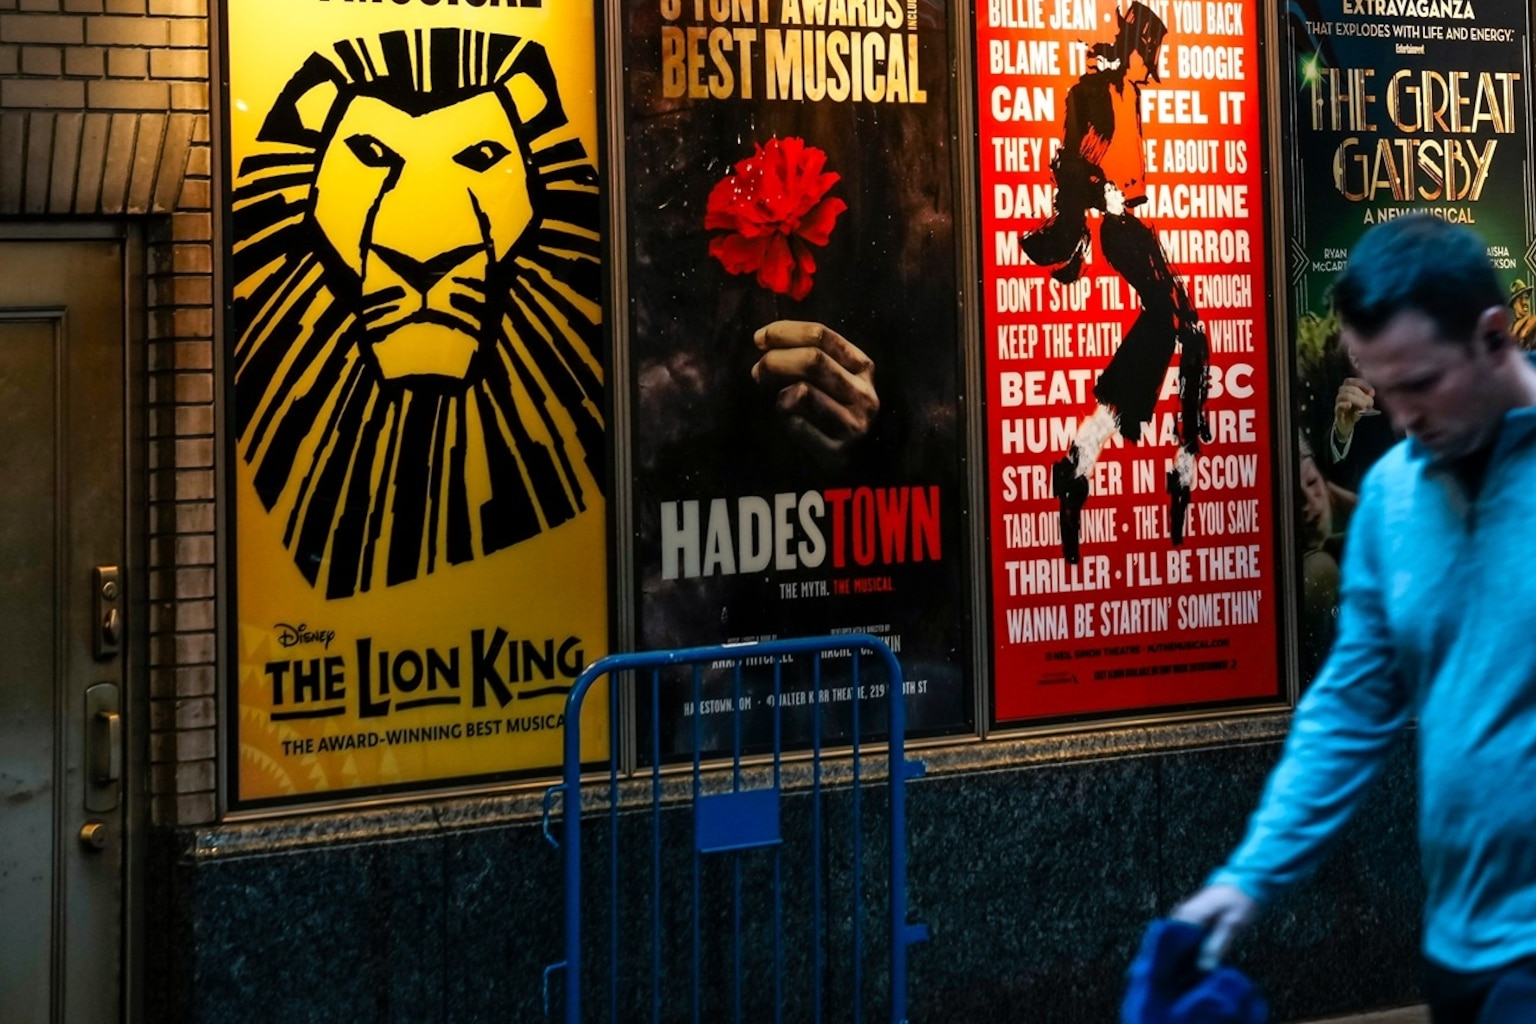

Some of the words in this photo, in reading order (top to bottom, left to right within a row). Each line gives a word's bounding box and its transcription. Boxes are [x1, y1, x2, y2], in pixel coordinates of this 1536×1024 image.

[1173, 0, 1202, 34] YOU
[1207, 1, 1243, 36] BACK
[1306, 21, 1332, 36] THAT
[1336, 22, 1391, 38] EXPLODES
[1392, 25, 1420, 39] WITH
[1422, 27, 1444, 40] LIFE
[1446, 28, 1468, 41] AND
[661, 26, 757, 100] BEST
[765, 29, 927, 104] MUSICAL
[990, 40, 1060, 75] BLAME
[1068, 41, 1088, 76] IT
[1178, 45, 1244, 80] BOOGIE
[991, 86, 1054, 122] CAN
[1142, 89, 1208, 124] FEEL
[1220, 91, 1245, 124] IT
[1305, 68, 1377, 132] THE
[1386, 69, 1521, 134] GREAT
[991, 137, 1042, 172] THEY
[1163, 139, 1219, 174] ABOUT
[1225, 140, 1247, 174] US
[1333, 137, 1498, 201] GATSBY
[1134, 184, 1249, 219] MACHINE
[1363, 208, 1374, 225] A
[1160, 229, 1250, 264] MIRROR
[1324, 248, 1347, 260] RYAN
[996, 277, 1045, 313] DON'T
[1049, 276, 1091, 312] STOP
[1095, 276, 1124, 310] 'TIL
[1194, 274, 1252, 308] ENOUGH
[998, 324, 1038, 360] KEEP
[1042, 323, 1073, 358] THE
[1078, 322, 1122, 358] FAITH
[1210, 319, 1254, 353] WHITE
[1000, 369, 1093, 407] BEAT
[1132, 459, 1155, 494] IN
[660, 485, 942, 580] HADESTOWN
[1003, 512, 1062, 549] TABLOID
[1133, 505, 1160, 540] THE
[1198, 501, 1224, 535] YOU
[1227, 499, 1259, 534] SAVE
[779, 582, 798, 599] THE
[801, 580, 830, 598] MYTH.
[833, 579, 851, 595] THE
[1005, 555, 1111, 596] THRILLER
[1126, 551, 1162, 587] I'LL
[1167, 549, 1193, 584] BE
[1196, 545, 1261, 581] THERE
[1006, 604, 1069, 644] WANNA
[1074, 603, 1095, 639] BE
[1101, 596, 1171, 637] STARTIN'
[1178, 590, 1262, 630] SOMETHIN'
[265, 655, 346, 706] THE
[356, 637, 461, 718] LION
[471, 626, 585, 708] KING
[281, 740, 314, 756] THE
[317, 722, 463, 753] AWARD-WINNING
[466, 719, 503, 738] BEST
